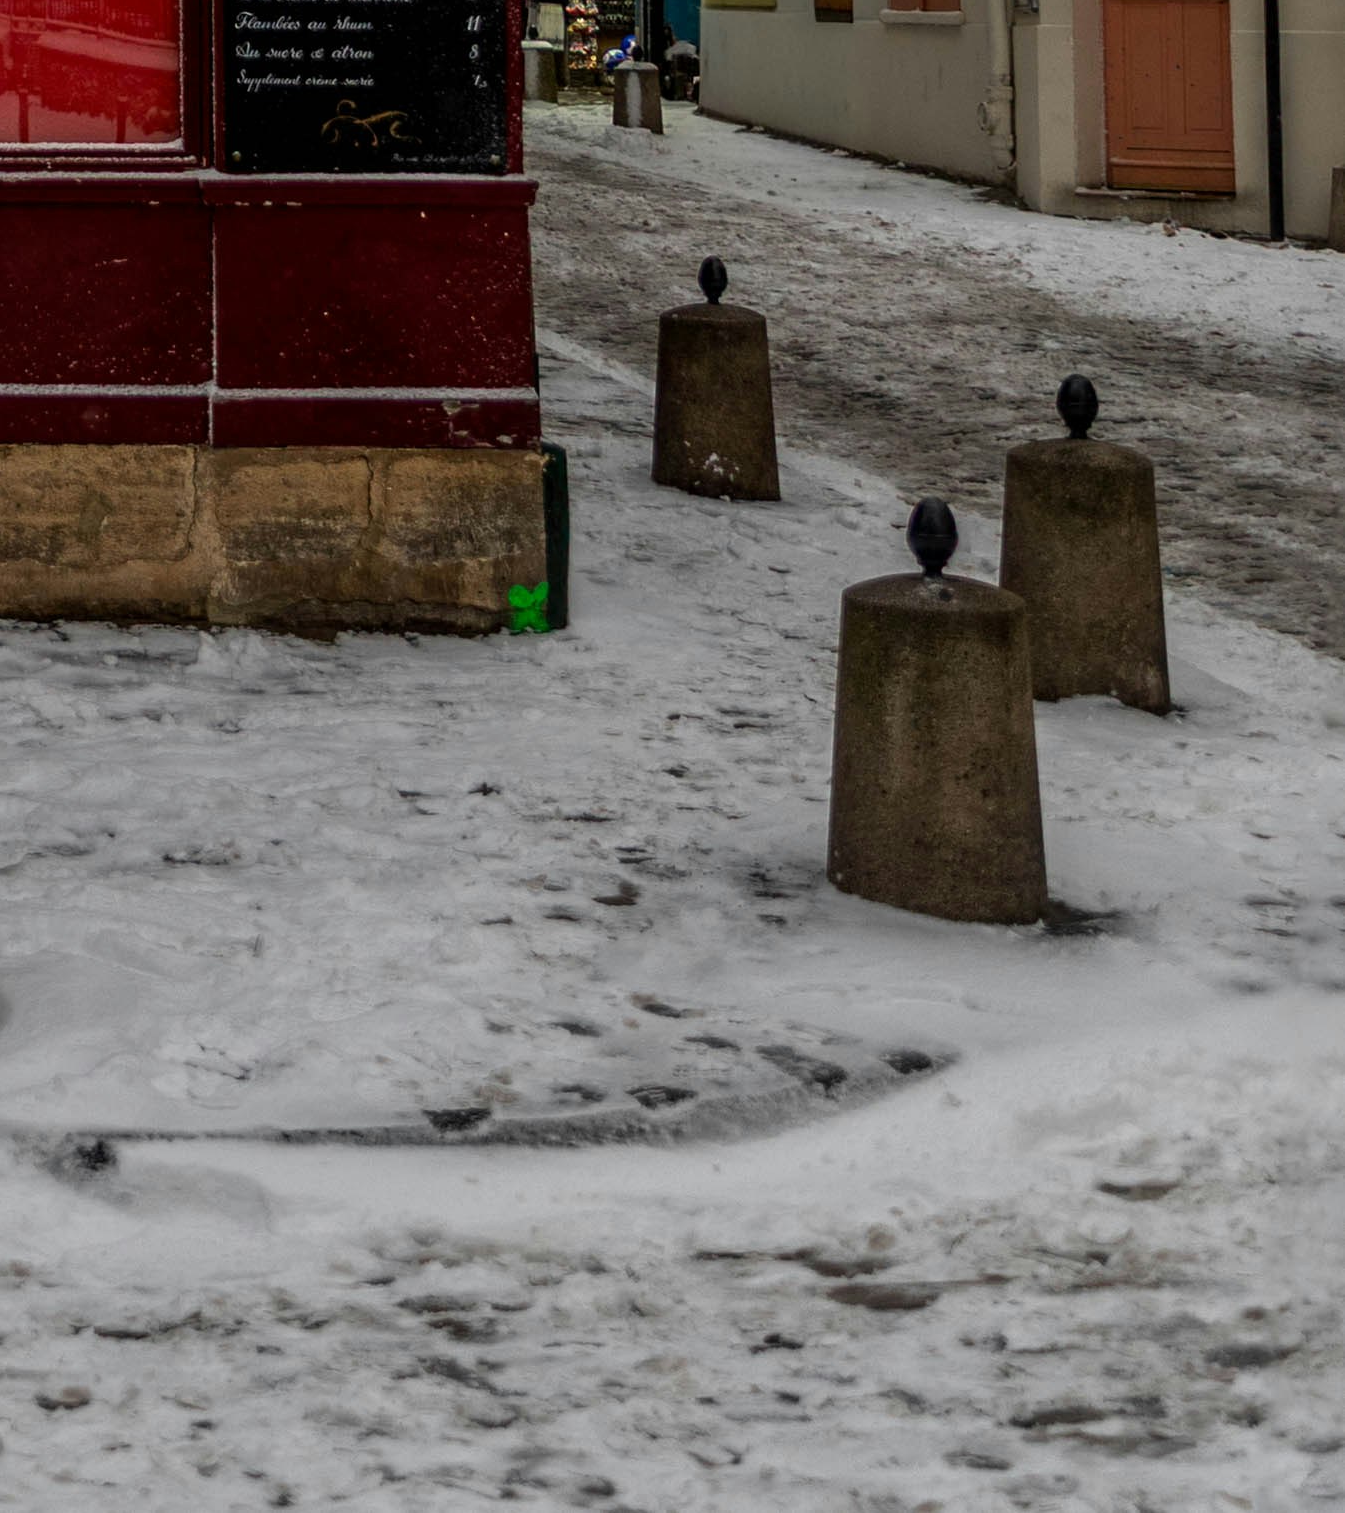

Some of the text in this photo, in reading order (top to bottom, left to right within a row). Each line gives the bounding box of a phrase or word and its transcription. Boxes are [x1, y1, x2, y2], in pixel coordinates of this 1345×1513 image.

[234, 11, 301, 31] Flambées
[307, 18, 327, 30] au
[266, 46, 303, 60] sucre
